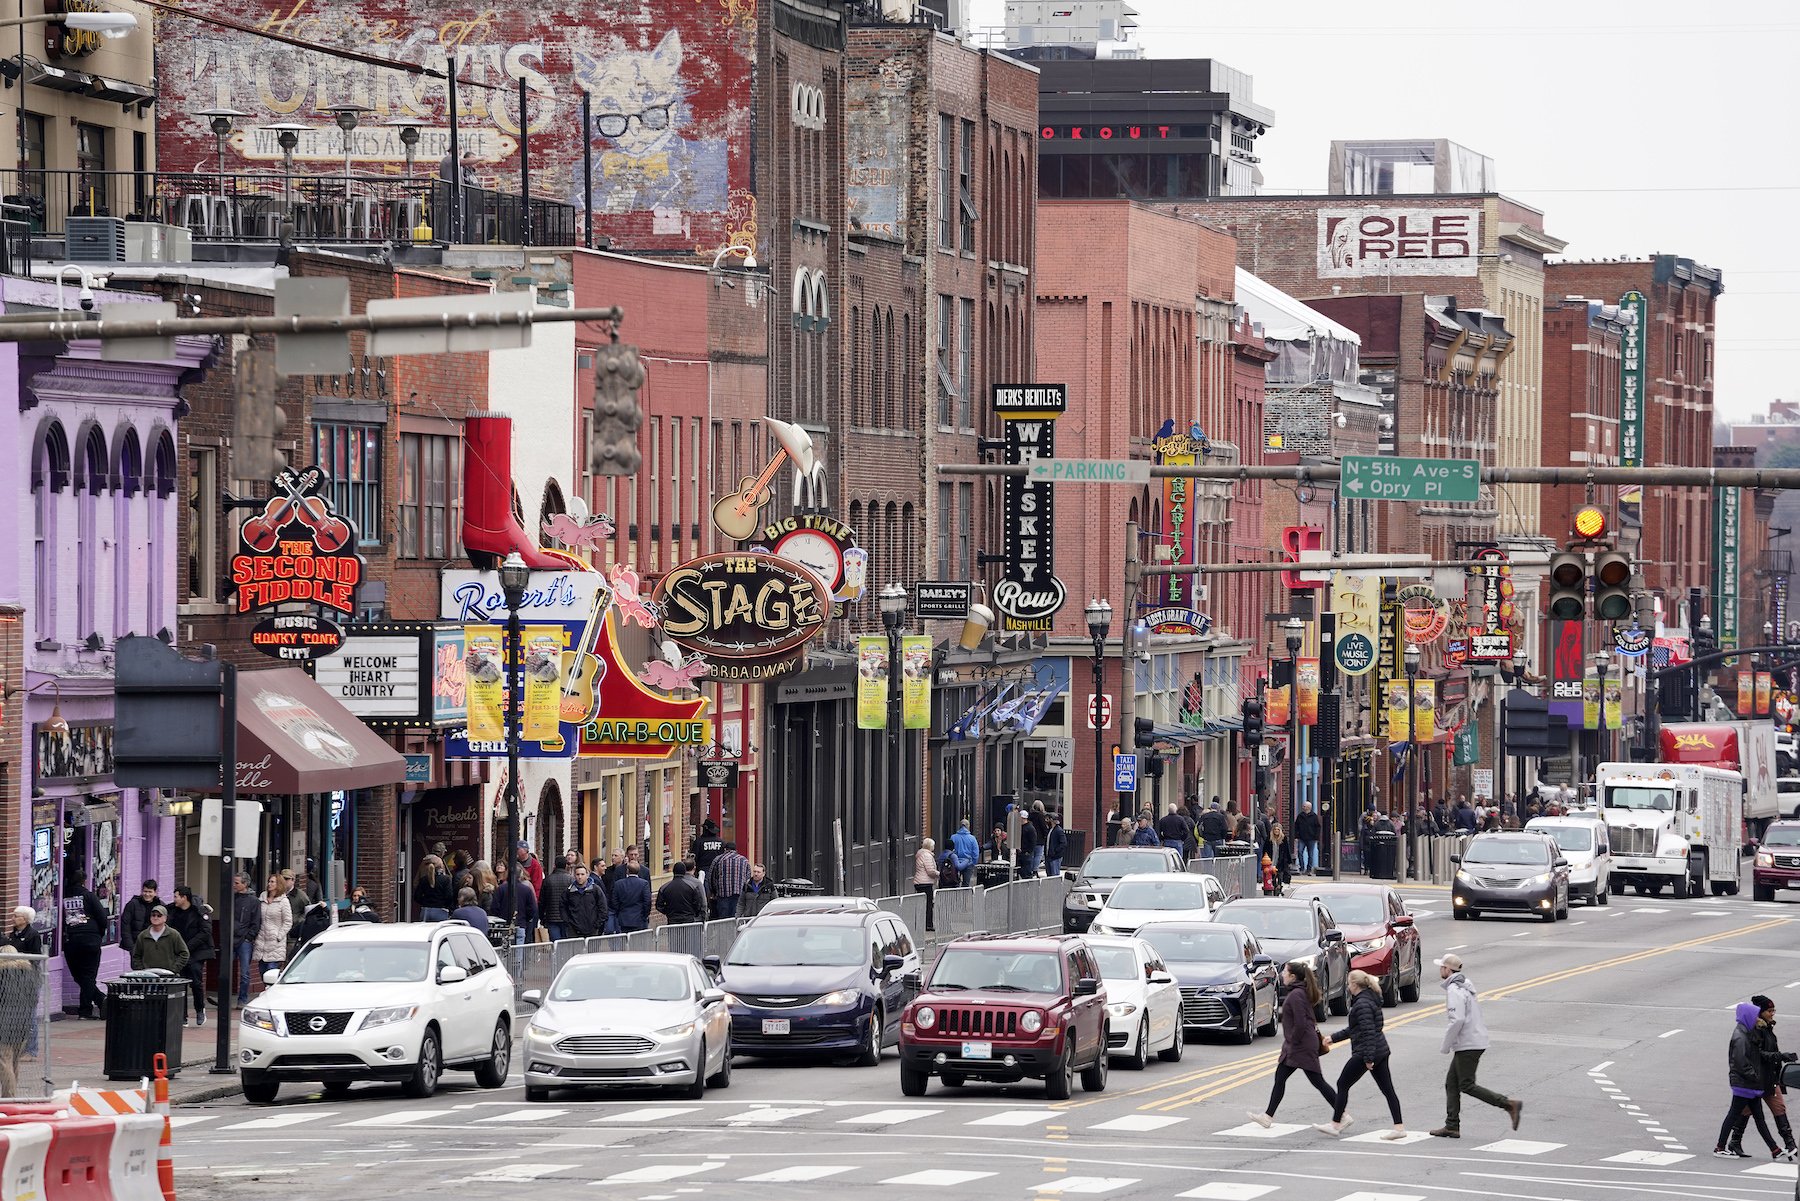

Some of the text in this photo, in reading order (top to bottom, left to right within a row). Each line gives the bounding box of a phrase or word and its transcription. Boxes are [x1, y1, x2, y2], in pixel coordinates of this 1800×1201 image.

[254, 131, 300, 153] WHN
[1359, 215, 1470, 237] OLE
[1359, 238, 1470, 259] RED
[996, 388, 1023, 406] DIERKS
[1053, 462, 1127, 480] PARKING
[1370, 480, 1442, 497] Opry Pl
[763, 514, 851, 542] BIG TIME
[1168, 462, 1190, 602] ARGARITAVLLE
[279, 540, 314, 556] THE
[233, 555, 360, 585] SECOND
[725, 557, 757, 573] THE
[238, 579, 354, 613] FIDDLE
[453, 575, 577, 621] Roert's
[664, 568, 822, 637] STAGE
[920, 589, 966, 599] BAILEY'S
[1000, 581, 1055, 610] Row
[1340, 593, 1370, 611] Tin
[274, 616, 318, 630] MUSIC
[1006, 616, 1052, 631] NASHVILLE
[1145, 609, 1206, 629] RESTAURANT BAR
[1337, 612, 1375, 633] Roof
[1415, 616, 1446, 642] KITCHEN
[253, 633, 339, 645] HONKY TONK
[1347, 642, 1364, 650] LIVE
[279, 647, 311, 660] CITY
[1341, 650, 1369, 659] MUSIC
[343, 656, 397, 669] WELCOME
[710, 658, 798, 679] BROADWAY
[1343, 659, 1368, 667] JOINT
[342, 685, 395, 697] COUNTRY
[1554, 681, 1582, 690] OLE
[1554, 689, 1582, 697] RED
[585, 721, 704, 744] BAR-B-QUE
[468, 740, 520, 753] GRIL
[1051, 740, 1069, 749] ONE
[1673, 733, 1716, 750] SAIA
[1050, 750, 1069, 759] WAY
[1120, 756, 1133, 764] TAXI
[424, 805, 478, 827] Robert's
[703, 841, 722, 851] STAFF
